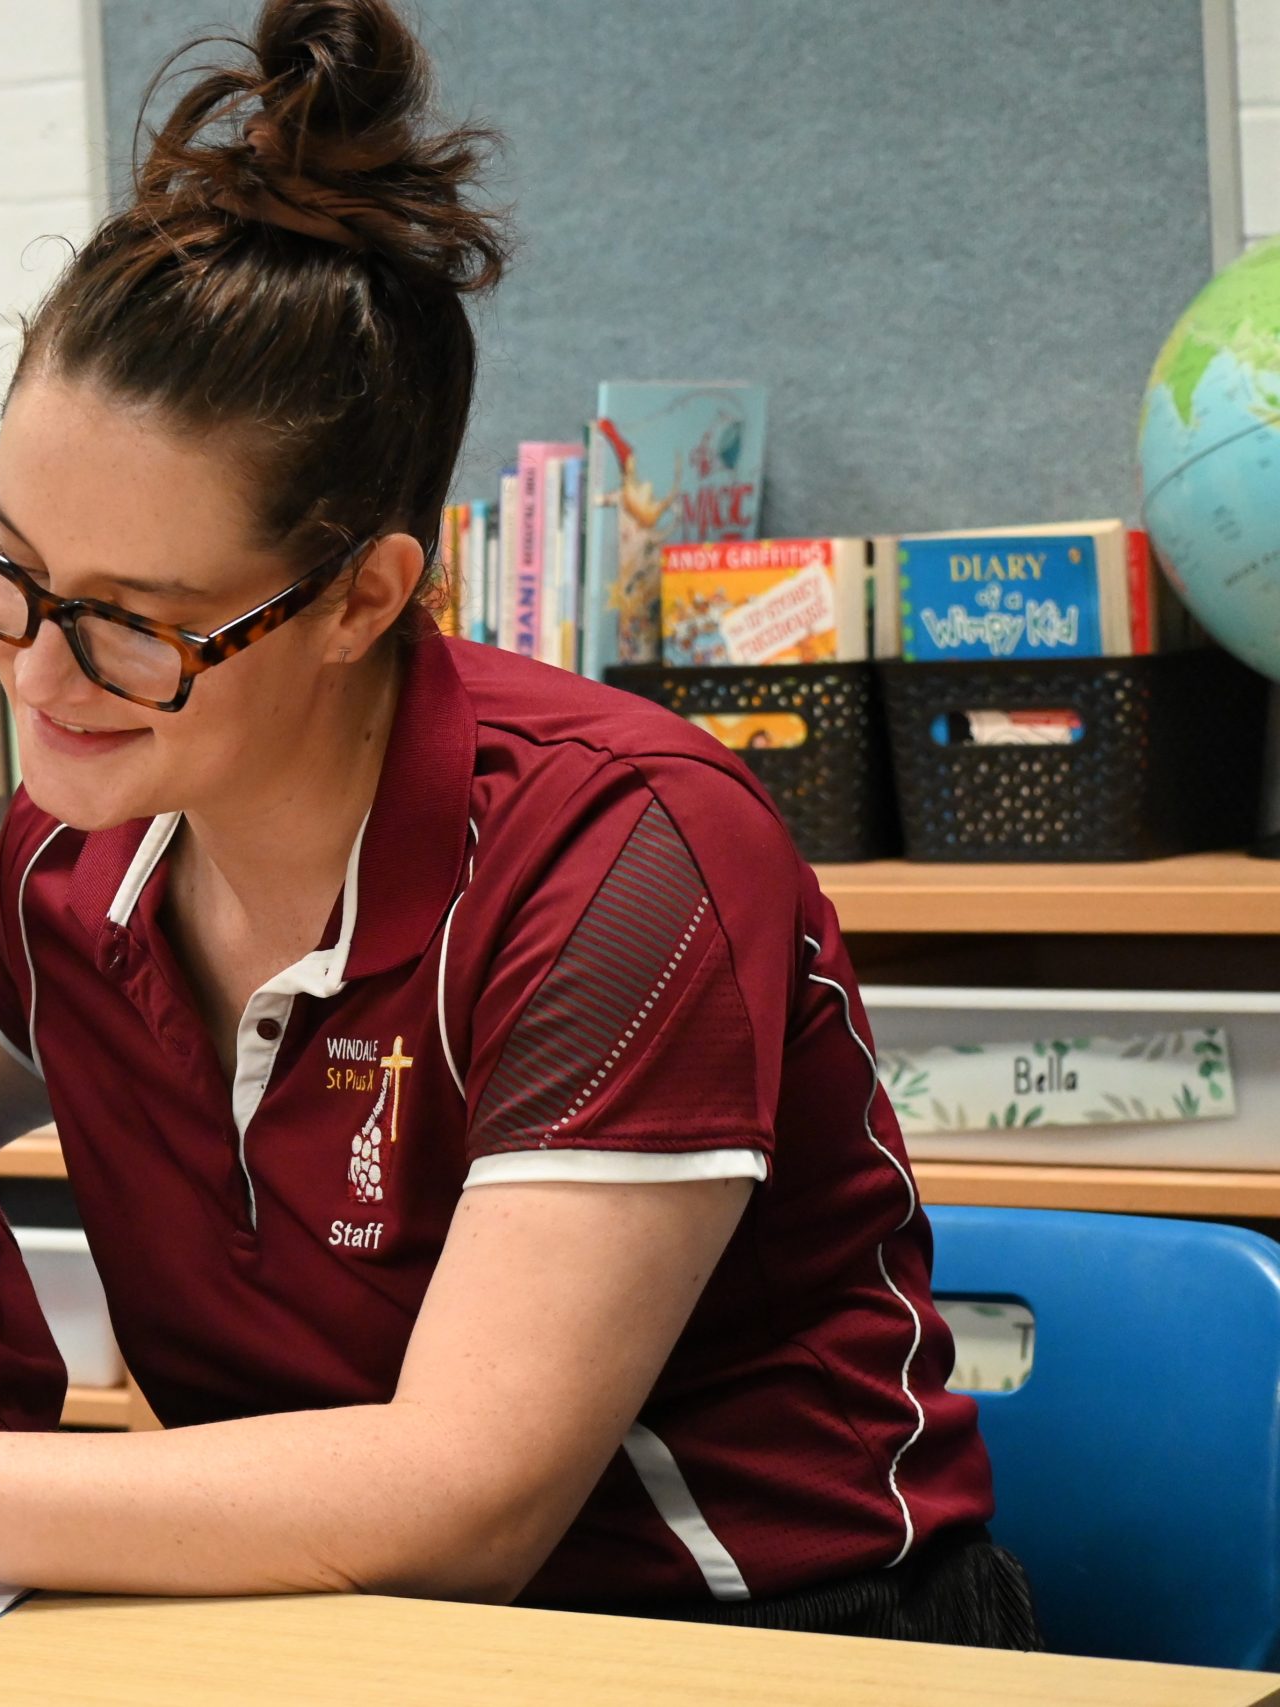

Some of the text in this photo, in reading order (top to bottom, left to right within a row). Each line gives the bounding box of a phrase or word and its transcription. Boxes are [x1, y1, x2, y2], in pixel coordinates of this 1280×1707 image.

[668, 542, 826, 571] ANDY GRIFFITHS
[949, 553, 1048, 582] DIARY
[975, 582, 1024, 611] of a
[920, 599, 1080, 657] Wimpy Kid
[326, 1036, 379, 1062] WINDALE
[326, 1067, 340, 1090] St
[1013, 1056, 1079, 1096] Bella
[328, 1220, 384, 1250] Staff
